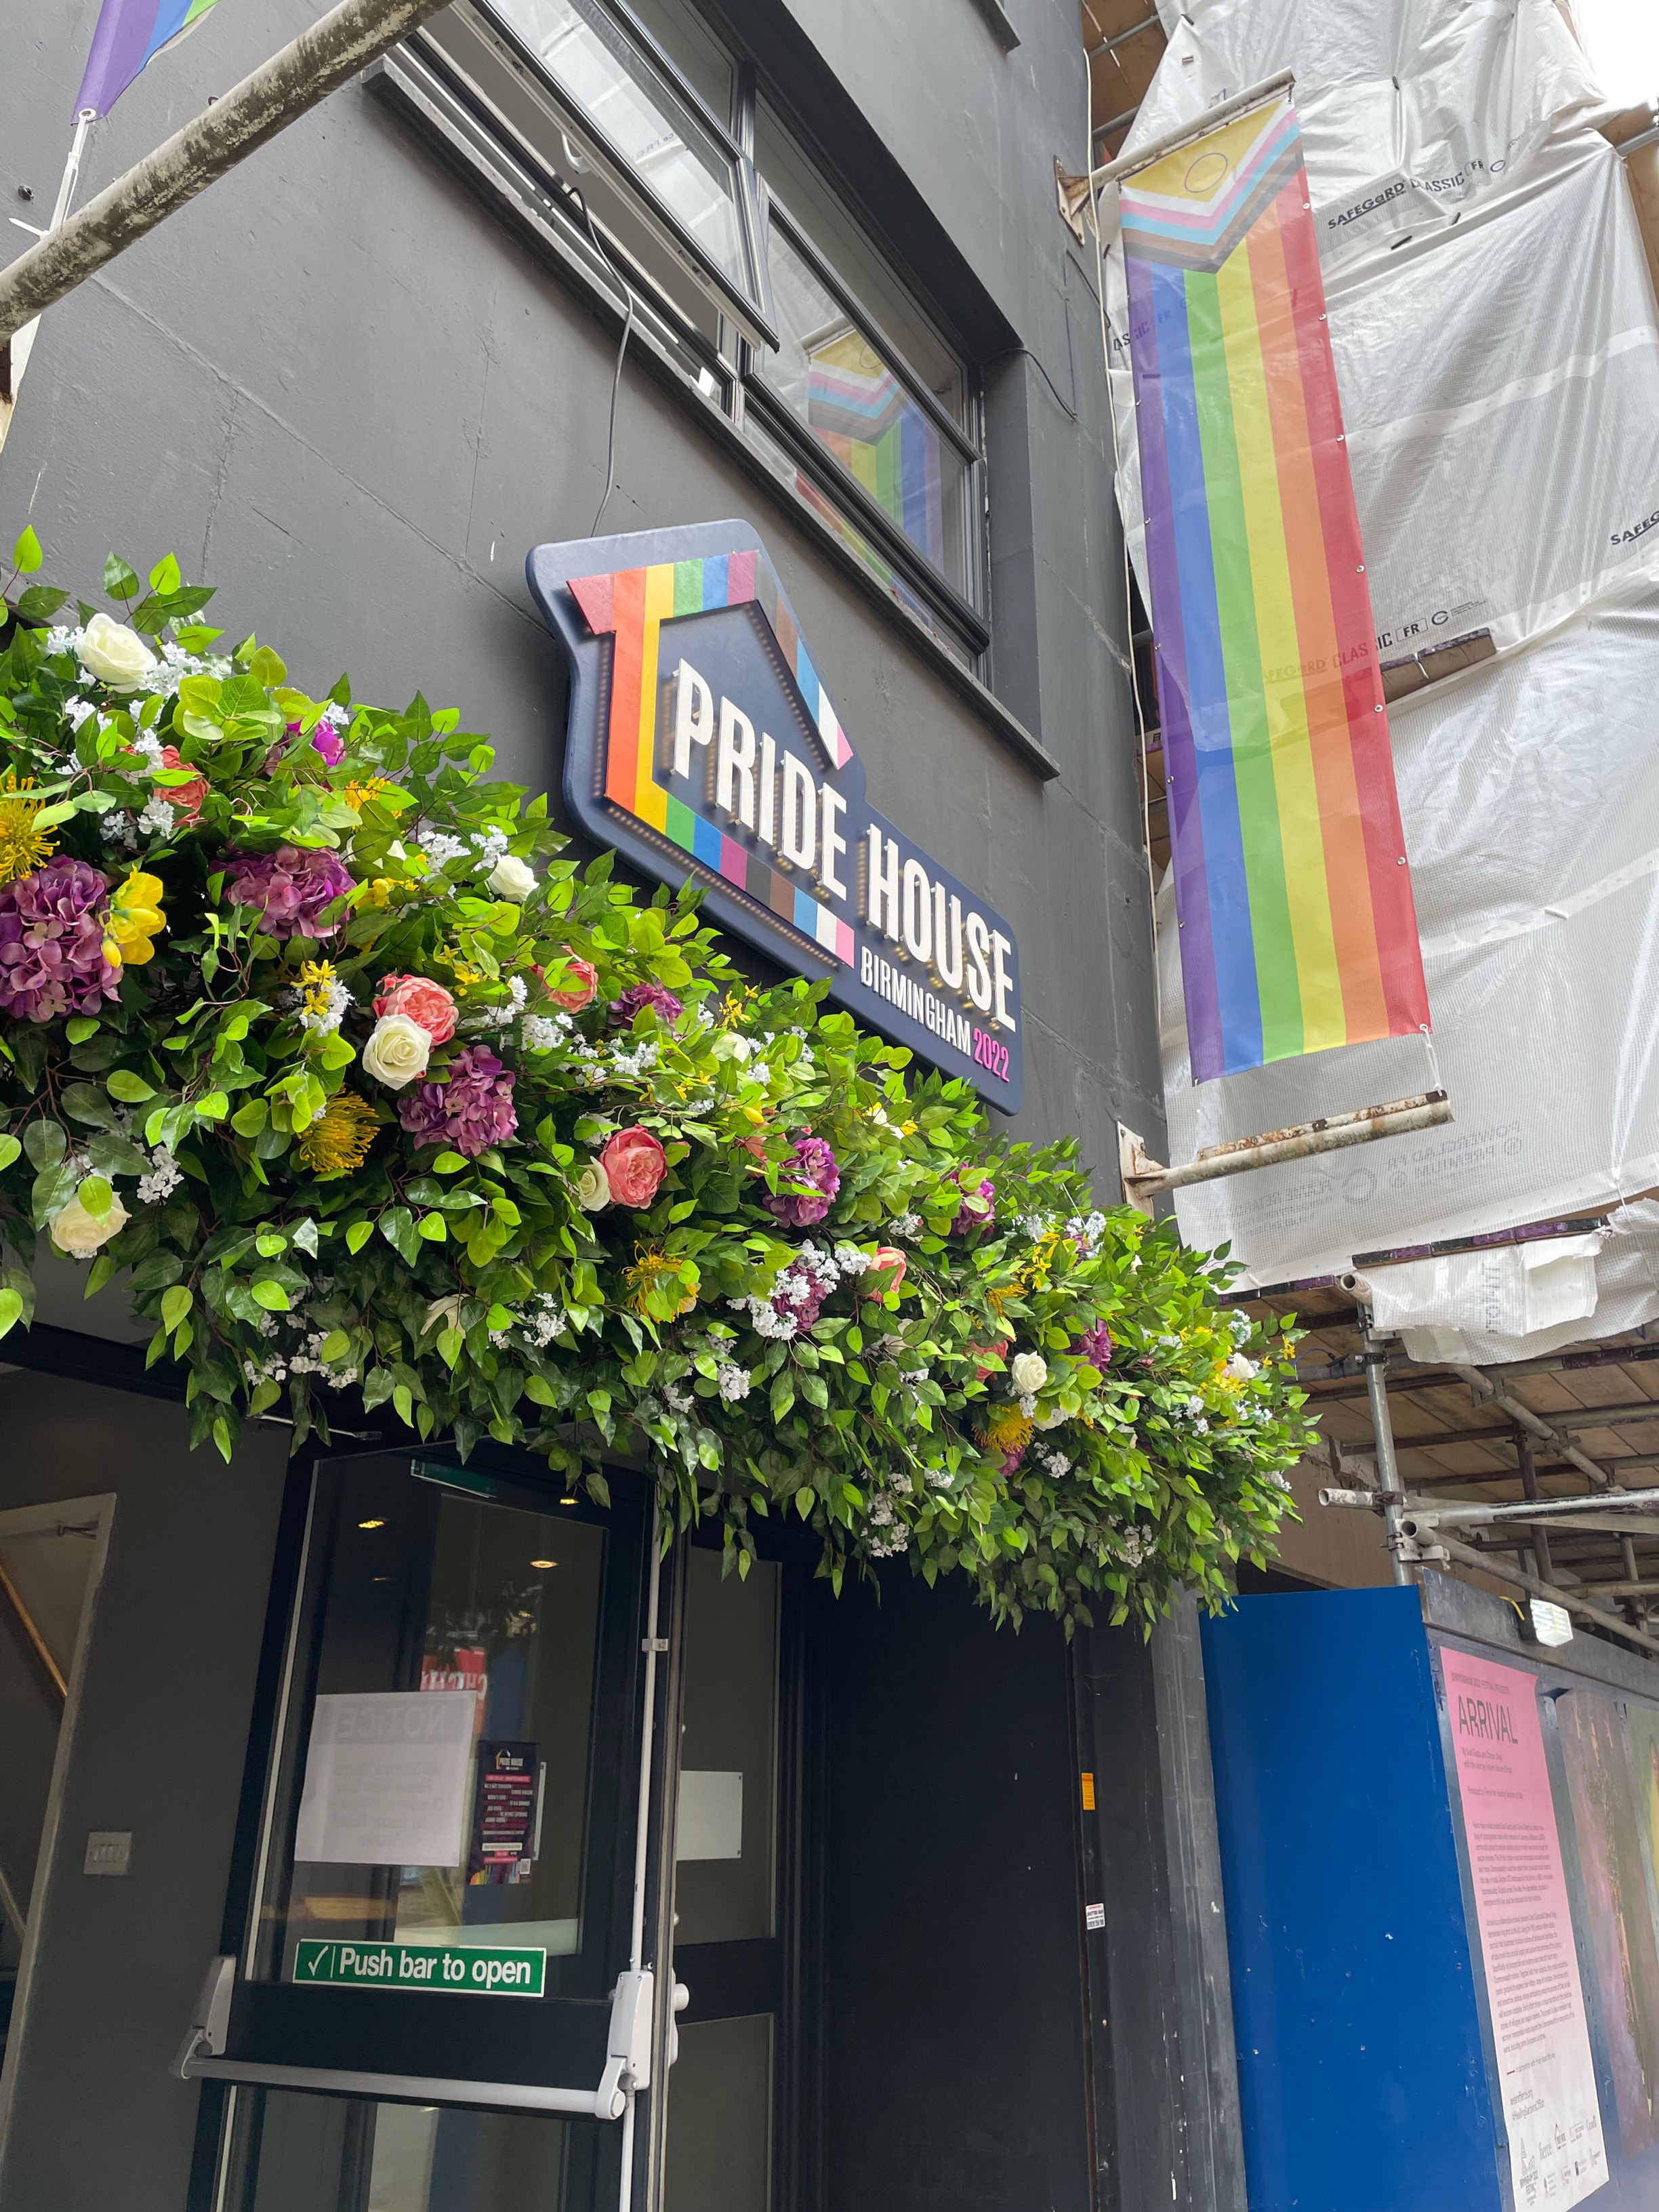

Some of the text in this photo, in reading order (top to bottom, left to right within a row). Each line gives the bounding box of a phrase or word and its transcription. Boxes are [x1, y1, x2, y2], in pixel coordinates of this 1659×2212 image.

[1471, 160, 1484, 170] FR
[1403, 623, 1420, 638] FR
[673, 658, 1016, 1033] PRIDE HOUSE
[861, 946, 1010, 1083] BIRMINGHAM 2022
[1458, 1695, 1519, 1745] ARRIVAL
[340, 1947, 531, 1989] Push bar to open
